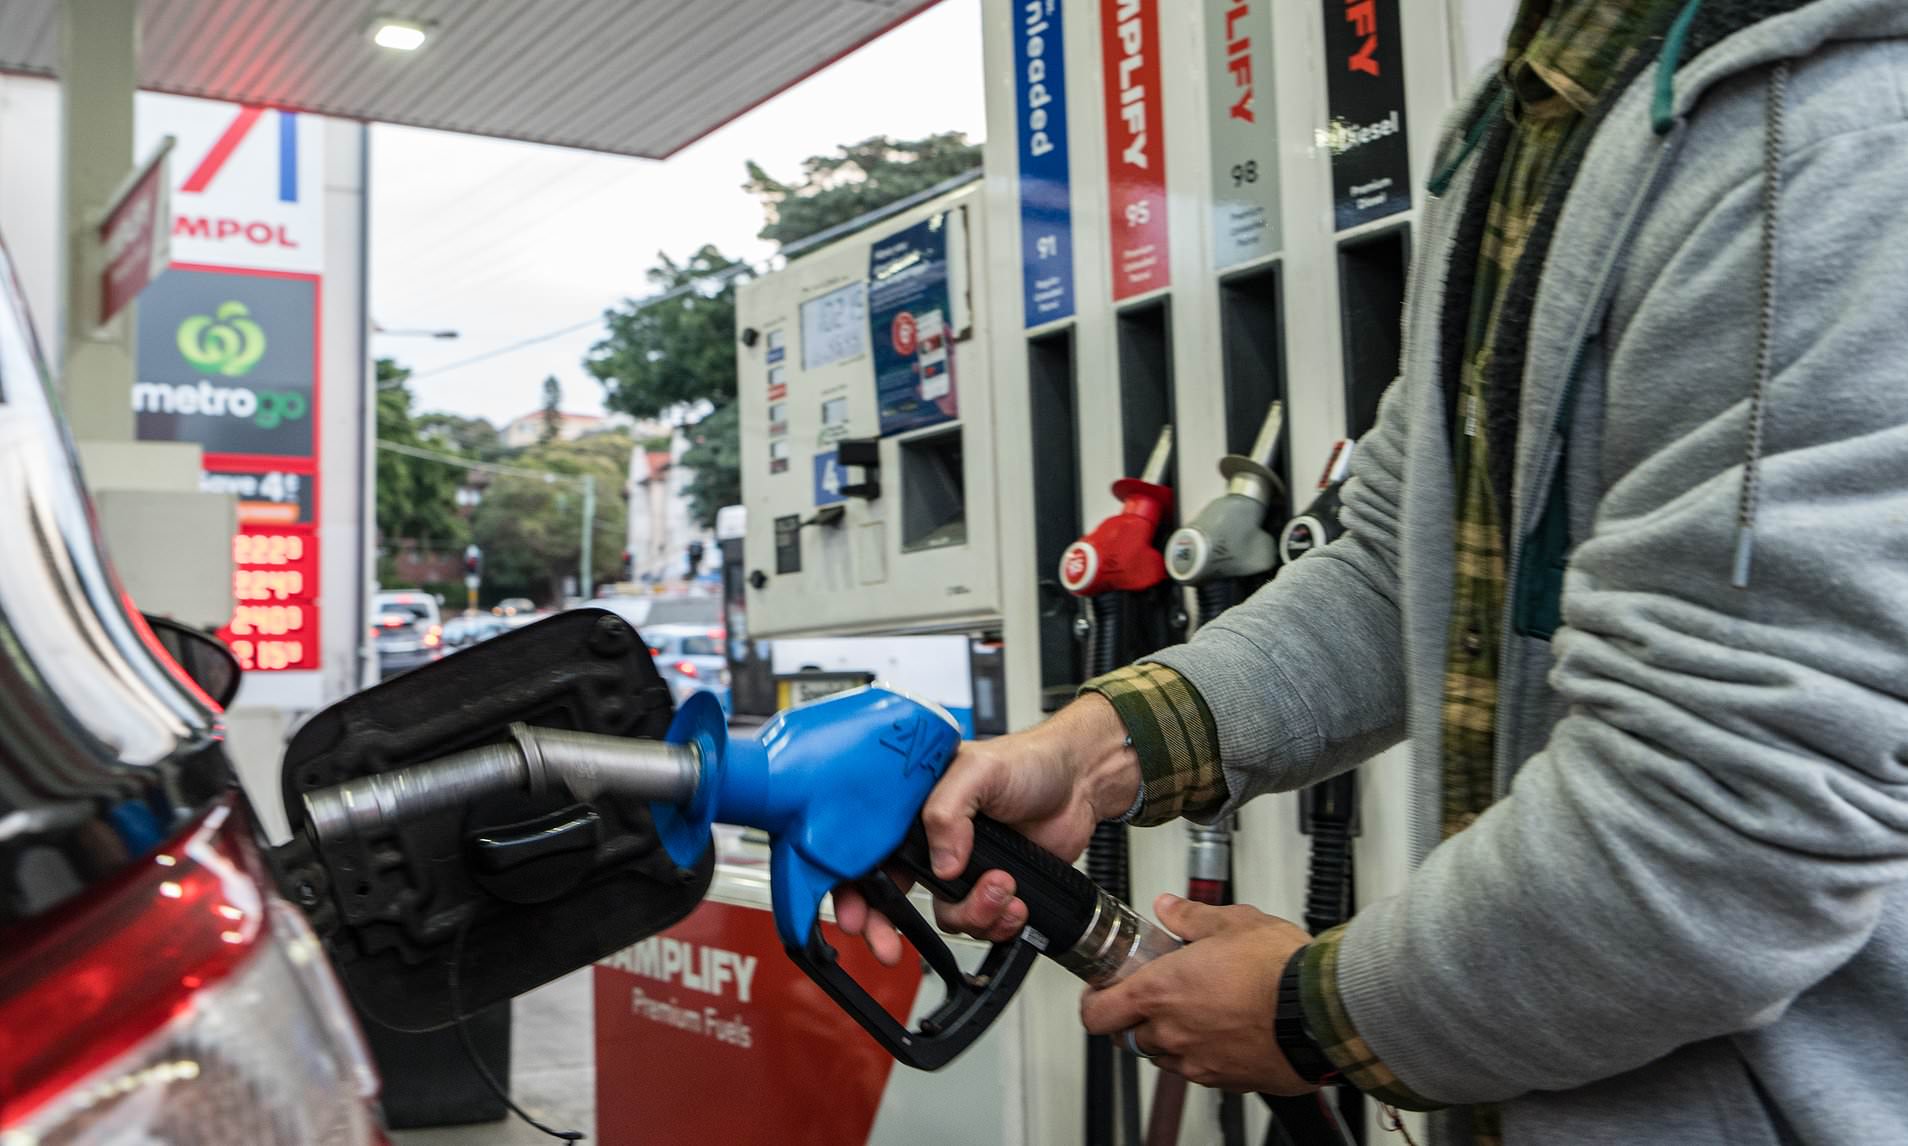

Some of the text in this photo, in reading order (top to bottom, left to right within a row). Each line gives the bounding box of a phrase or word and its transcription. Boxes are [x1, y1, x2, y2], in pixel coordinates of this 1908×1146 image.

[1223, 0, 1256, 124] LIFY
[1231, 160, 1259, 188] 98
[1125, 200, 1150, 227] 95
[1036, 234, 1057, 260] 91
[132, 380, 306, 429] metrogo
[821, 458, 841, 495] 4
